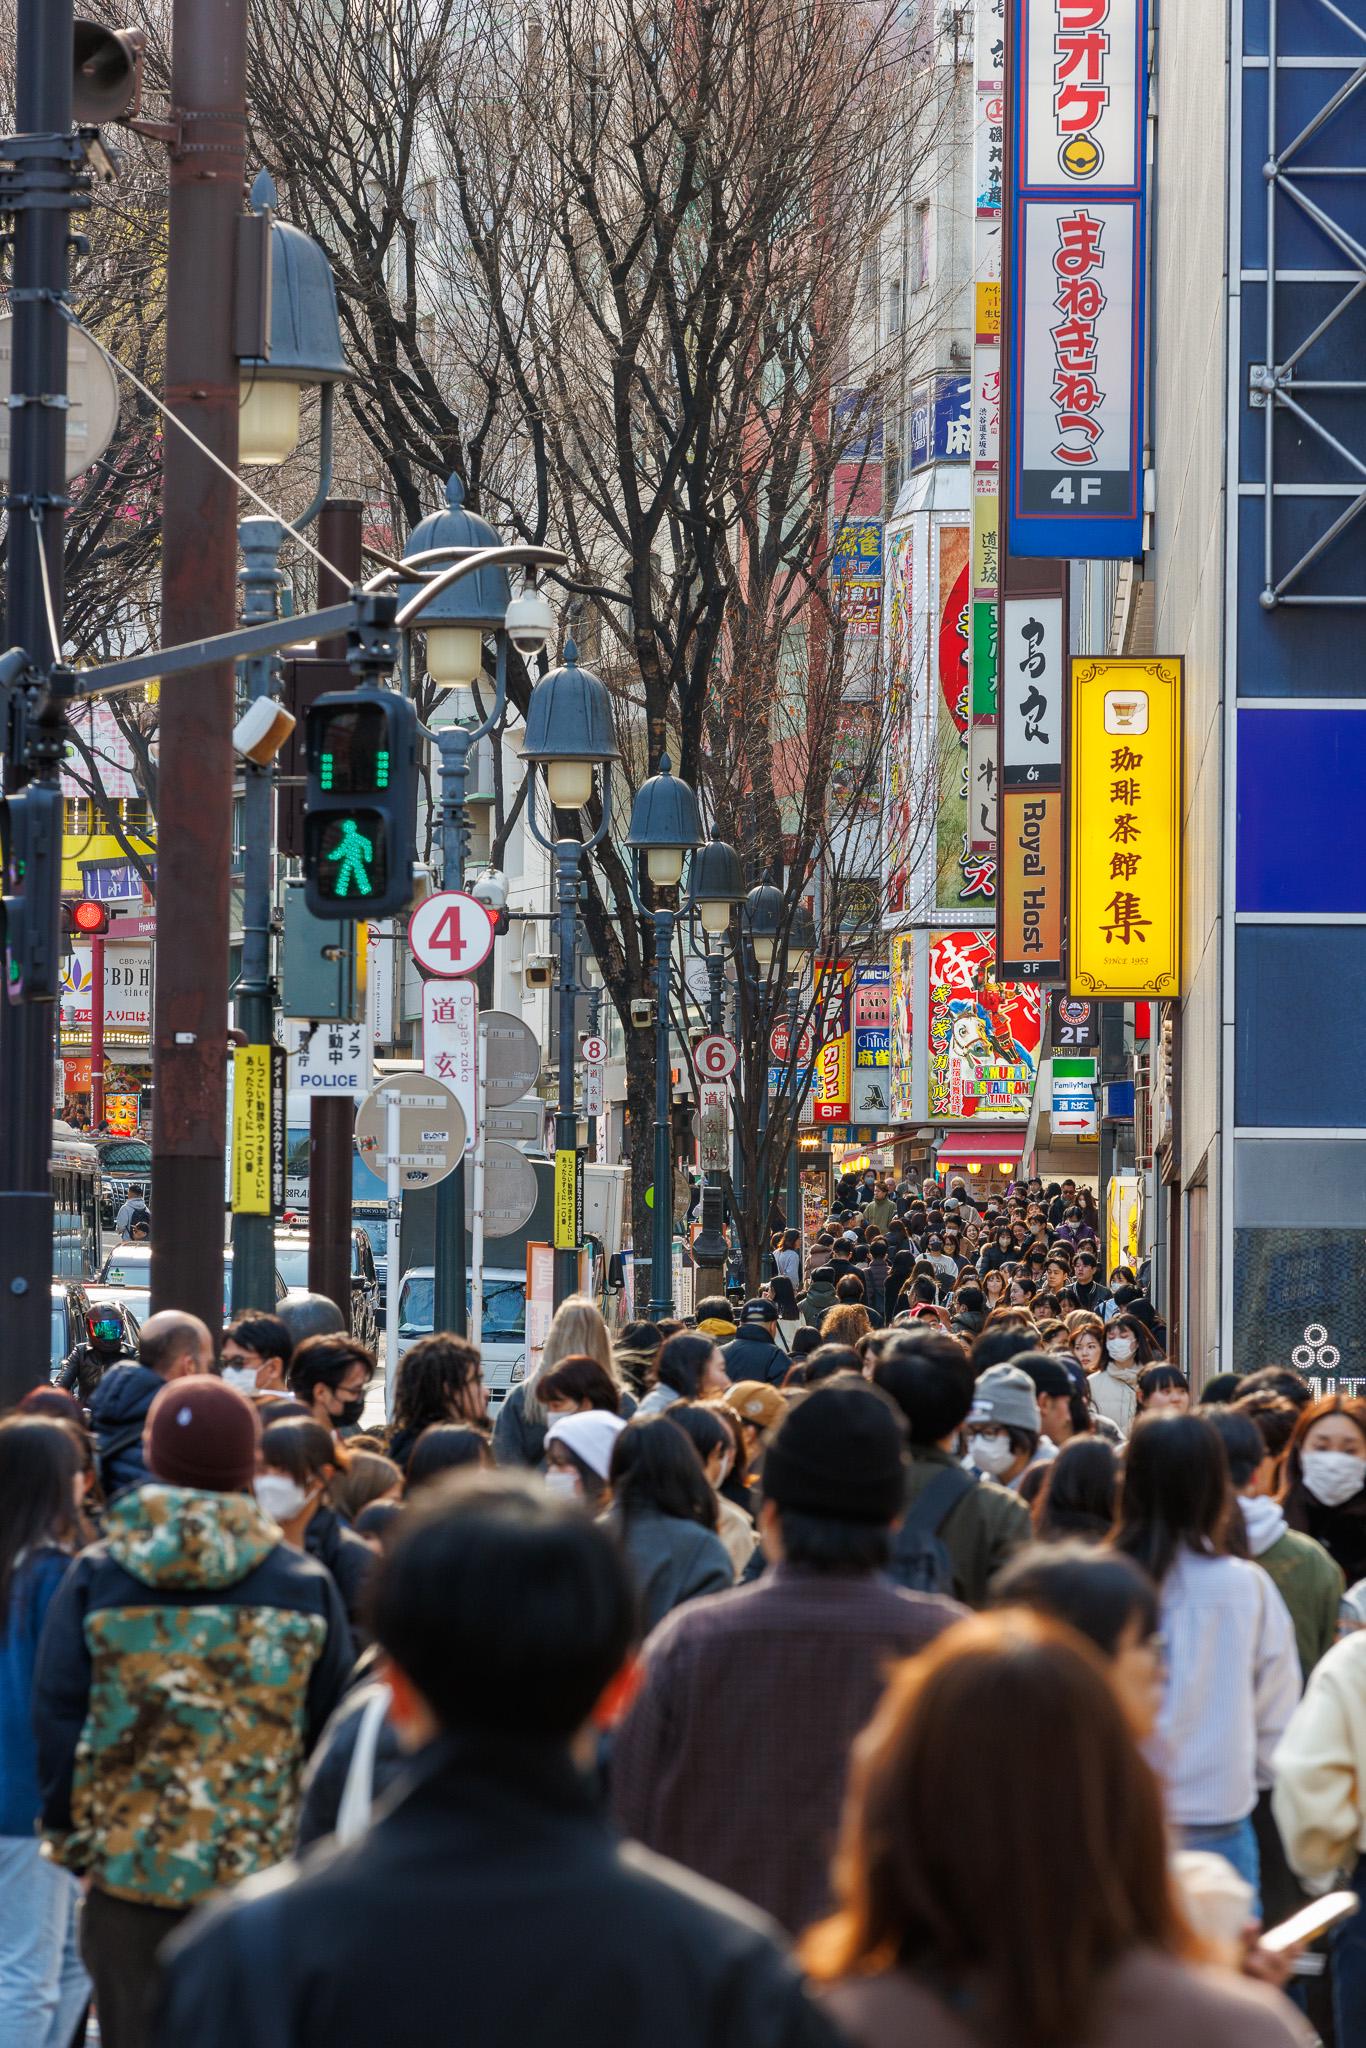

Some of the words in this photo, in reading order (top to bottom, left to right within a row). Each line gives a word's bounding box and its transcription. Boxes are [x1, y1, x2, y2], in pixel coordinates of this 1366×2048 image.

[1051, 209, 1107, 467] まねきねこ
[979, 408, 987, 457] 渋谷道玄坂店
[1050, 477, 1102, 504] 4F
[1026, 768, 1040, 781] 6F
[1110, 746, 1143, 882] 珈琲茶館
[1019, 799, 1047, 877] Royal
[1021, 887, 1047, 953] Host
[1099, 890, 1153, 946] 集
[428, 906, 467, 961] 4
[1023, 963, 1040, 973] 3F
[1060, 1026, 1090, 1044] 2F
[588, 1041, 600, 1059] 8
[705, 1042, 726, 1070] 6
[857, 1049, 889, 1066] 麻雀
[931, 984, 952, 1115] ギラギラガールズ
[300, 1074, 358, 1087] POLICE
[824, 1045, 839, 1100] カフェ
[975, 1065, 1026, 1080] SAMURAI
[1054, 1081, 1092, 1091] FamilyMar
[589, 1070, 598, 1112] 道玄坂
[989, 1094, 1011, 1104] TIME
[821, 1105, 843, 1118] 6F
[704, 1091, 718, 1161] 道玄坂
